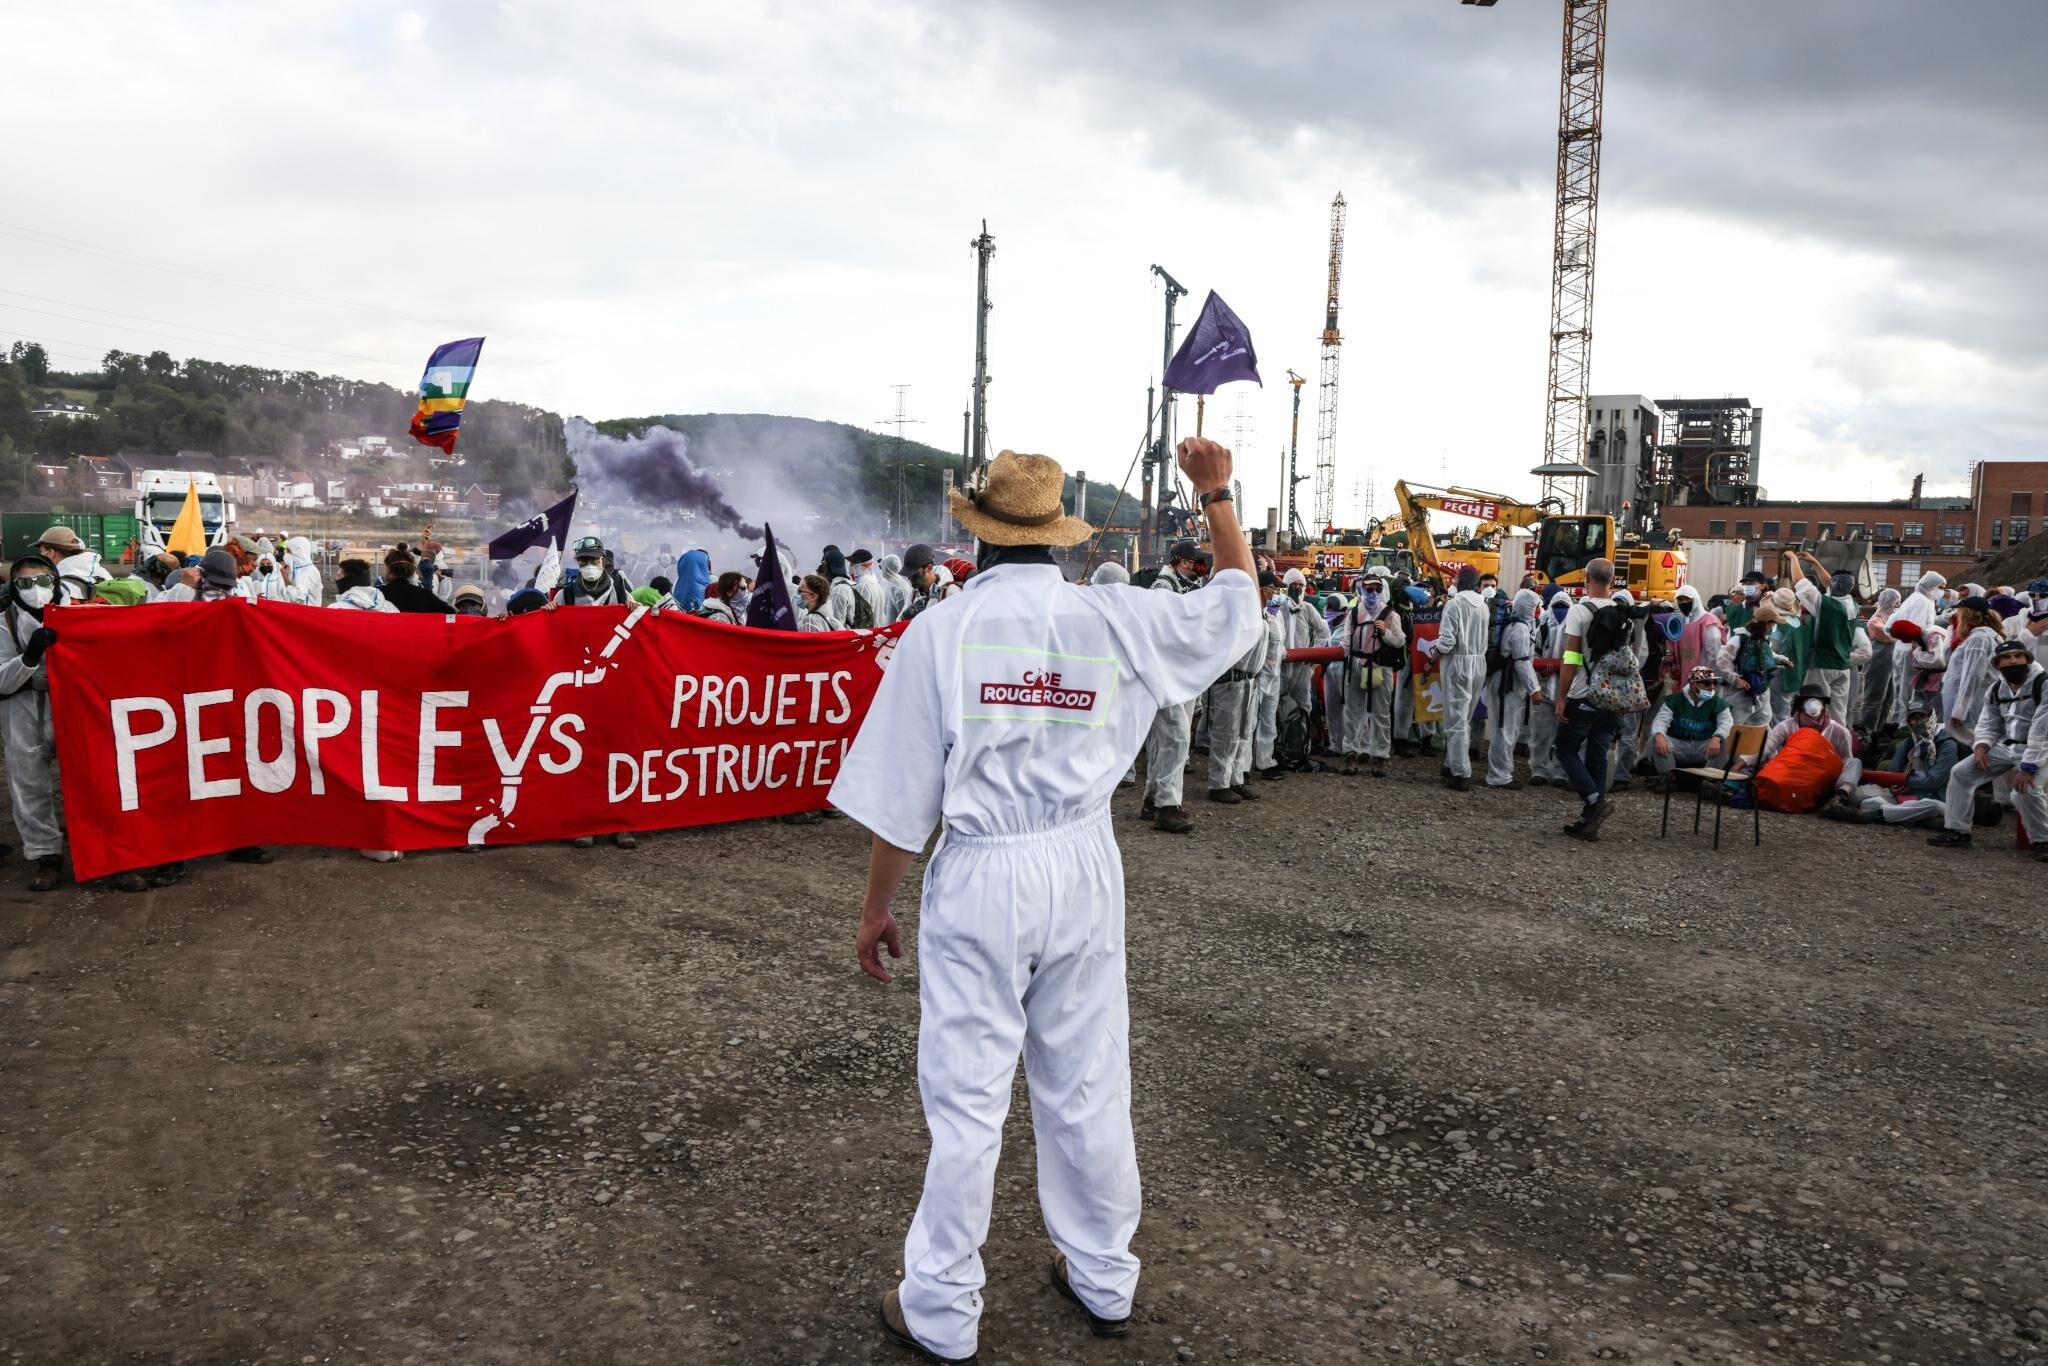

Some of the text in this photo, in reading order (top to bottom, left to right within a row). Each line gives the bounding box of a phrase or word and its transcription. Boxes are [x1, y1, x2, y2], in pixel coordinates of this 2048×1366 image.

[1444, 502, 1495, 519] PECHE
[1315, 554, 1344, 568] CHE
[1023, 671, 1062, 687] CDE
[670, 671, 852, 728] PROJETS
[111, 688, 469, 811] PEOPLE
